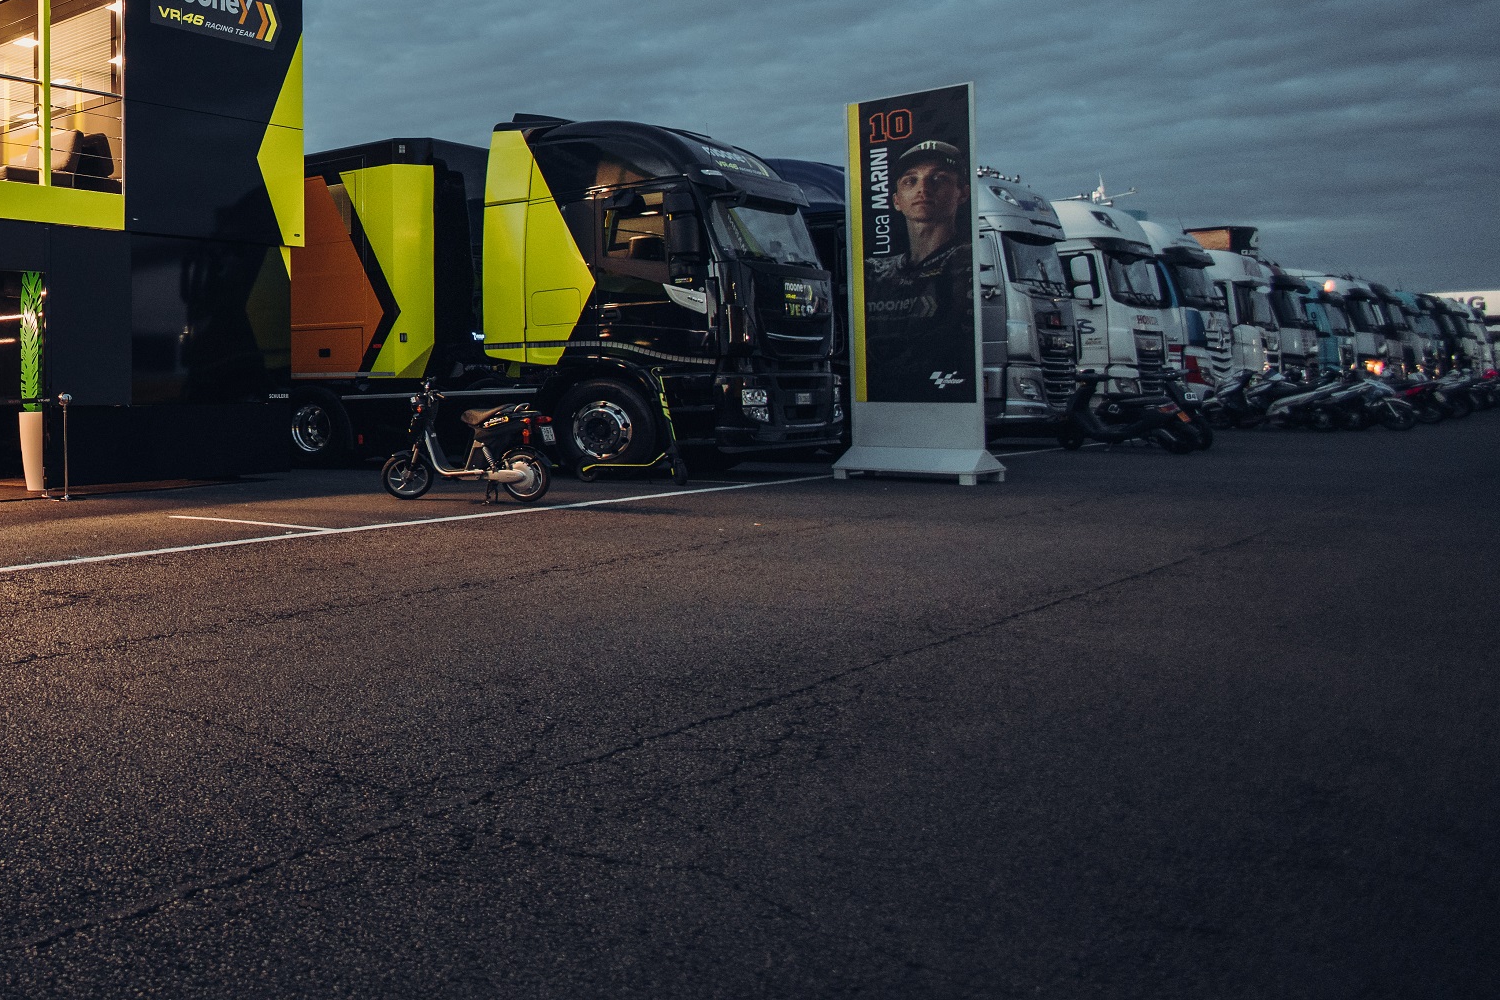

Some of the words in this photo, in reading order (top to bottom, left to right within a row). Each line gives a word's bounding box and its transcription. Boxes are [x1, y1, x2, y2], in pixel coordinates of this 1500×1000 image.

[205, 21, 234, 34] RACING
[235, 28, 255, 39] TEAM
[869, 108, 913, 143] 10
[870, 147, 890, 210] MARINI
